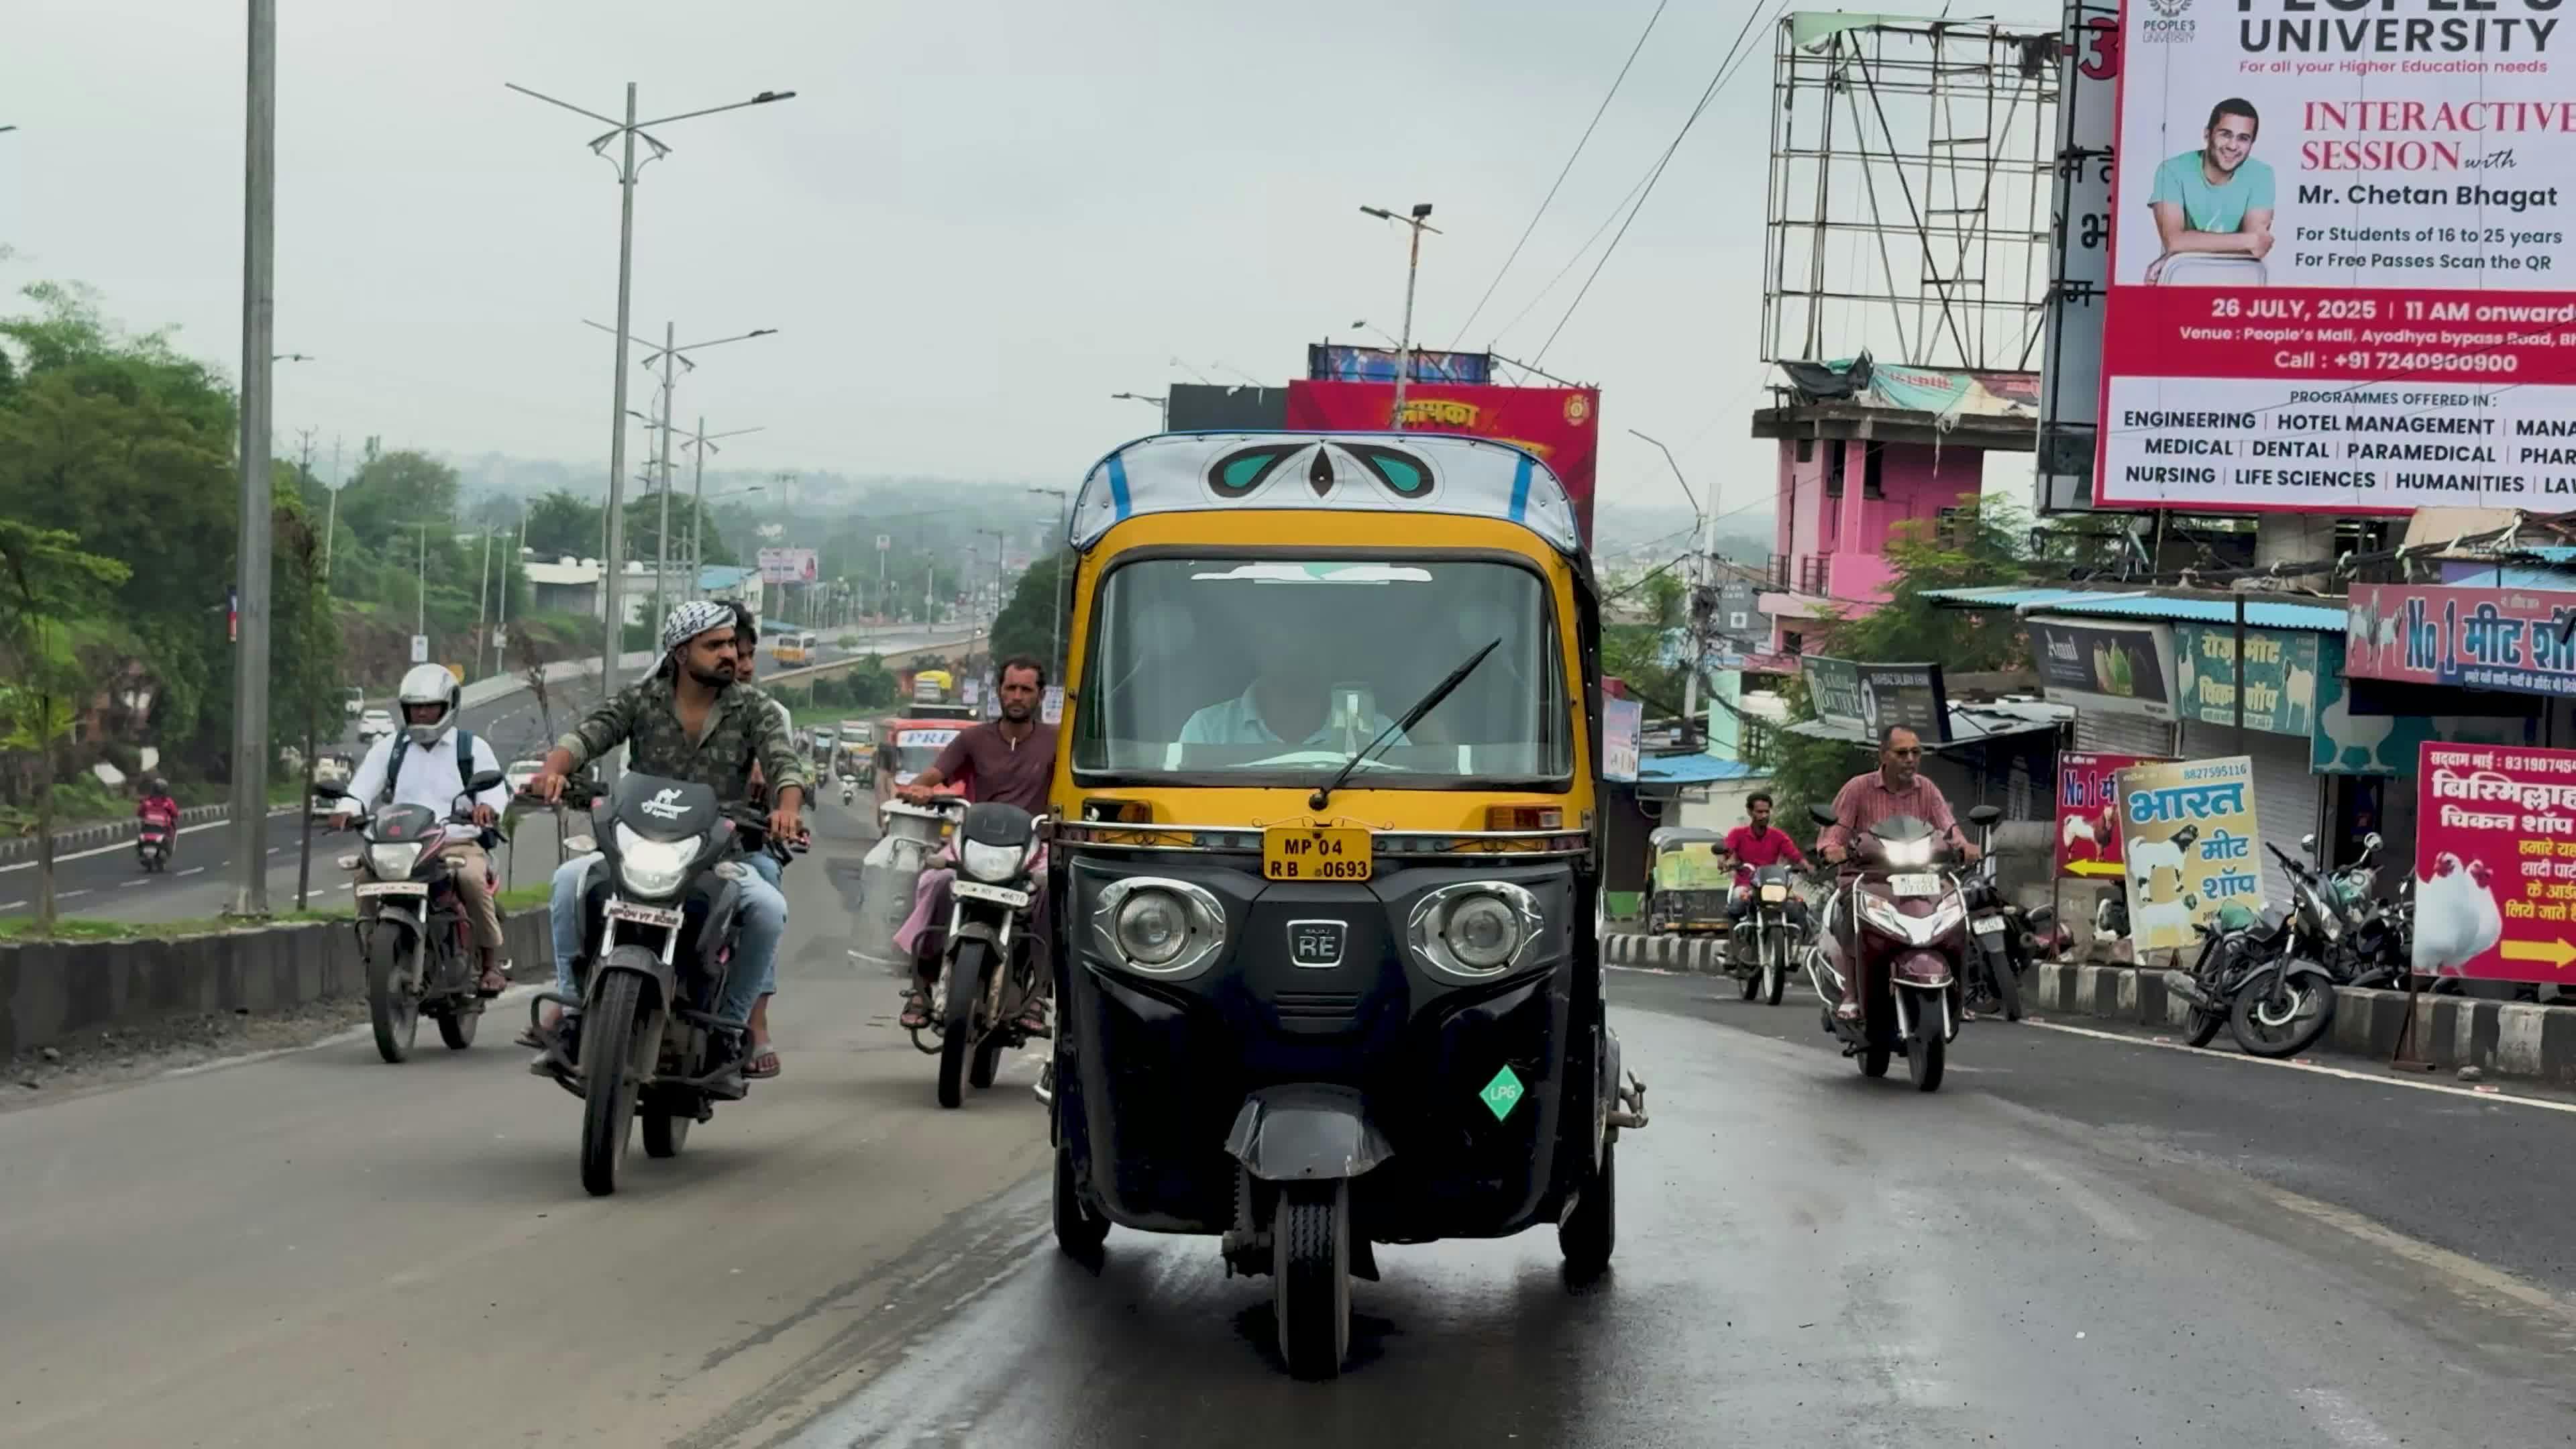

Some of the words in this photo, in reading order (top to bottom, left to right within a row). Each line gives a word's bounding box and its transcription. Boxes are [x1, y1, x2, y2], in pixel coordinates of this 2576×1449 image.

[2143, 19, 2196, 31] PEOPLE'S
[2240, 18, 2559, 52] UNIVERSITY
[2143, 32, 2195, 44] UNIVERSITY
[2239, 61, 2265, 73] For
[2271, 60, 2290, 73] all
[2296, 62, 2334, 76] your
[2340, 60, 2396, 76] Higher
[2402, 60, 2487, 73] Education
[2494, 60, 2547, 73] needs
[2304, 101, 2576, 132] INTERACTIVE
[2301, 140, 2461, 171] SESSION
[2464, 148, 2517, 169] with
[2298, 184, 2339, 205] Mr.
[2347, 185, 2447, 205] Chetan
[2456, 186, 2558, 212] Bhagat
[2297, 227, 2324, 241] For
[2329, 227, 2410, 242] Students
[2415, 227, 2433, 242] of
[2438, 229, 2455, 242] 16
[2461, 229, 2479, 243] to
[2483, 229, 2505, 243] 25
[2510, 231, 2563, 248] years
[2295, 253, 2323, 266] For
[2328, 253, 2367, 267] Free
[2371, 254, 2434, 268] Passes
[2440, 254, 2485, 268] Scan
[2490, 255, 2520, 270] the
[2526, 256, 2551, 272] QR
[2212, 299, 2239, 317] 26
[2246, 299, 2311, 321] JULY,
[2317, 300, 2377, 319] 2025
[2405, 301, 2423, 320] 11
[2429, 303, 2470, 321] AM
[2475, 303, 2576, 323] onward
[2361, 329, 2436, 347] Ayodhya
[2441, 331, 2502, 347] bypass
[2275, 351, 2314, 368] Call
[2334, 352, 2370, 369] +91
[2290, 390, 2398, 405] PROGRAMMES
[2403, 392, 2468, 406] OFFERED
[2125, 411, 2255, 429] ENGINEERING
[2277, 415, 2341, 431] HOTEL
[2346, 415, 2494, 435] MANAGEMENT
[2145, 438, 2233, 455] MEDICAL
[2253, 440, 2329, 458] DENTAL
[2348, 443, 2496, 462] PARAMEDICAL
[2126, 466, 2215, 483] NURSING
[2235, 469, 2272, 485] LIFE
[2277, 470, 2375, 488] SCIENCES
[2396, 472, 2524, 492] HUMANITIES
[2405, 596, 2436, 671] No
[2444, 598, 2457, 675] 1
[2463, 601, 2526, 666] मीट
[2063, 769, 2085, 808] No
[2129, 782, 2245, 824] भारत
[2440, 804, 2516, 830] चिकन
[2522, 812, 2573, 834] शॉप
[1285, 839, 1311, 855] MP
[1319, 839, 1342, 855] 04
[2200, 828, 2249, 861] मीट
[1324, 861, 1367, 877] 0693
[2202, 866, 2257, 899] शॉप
[2526, 879, 2542, 897] के
[1299, 936, 1335, 956] RE
[1491, 1085, 1516, 1101] LPG
